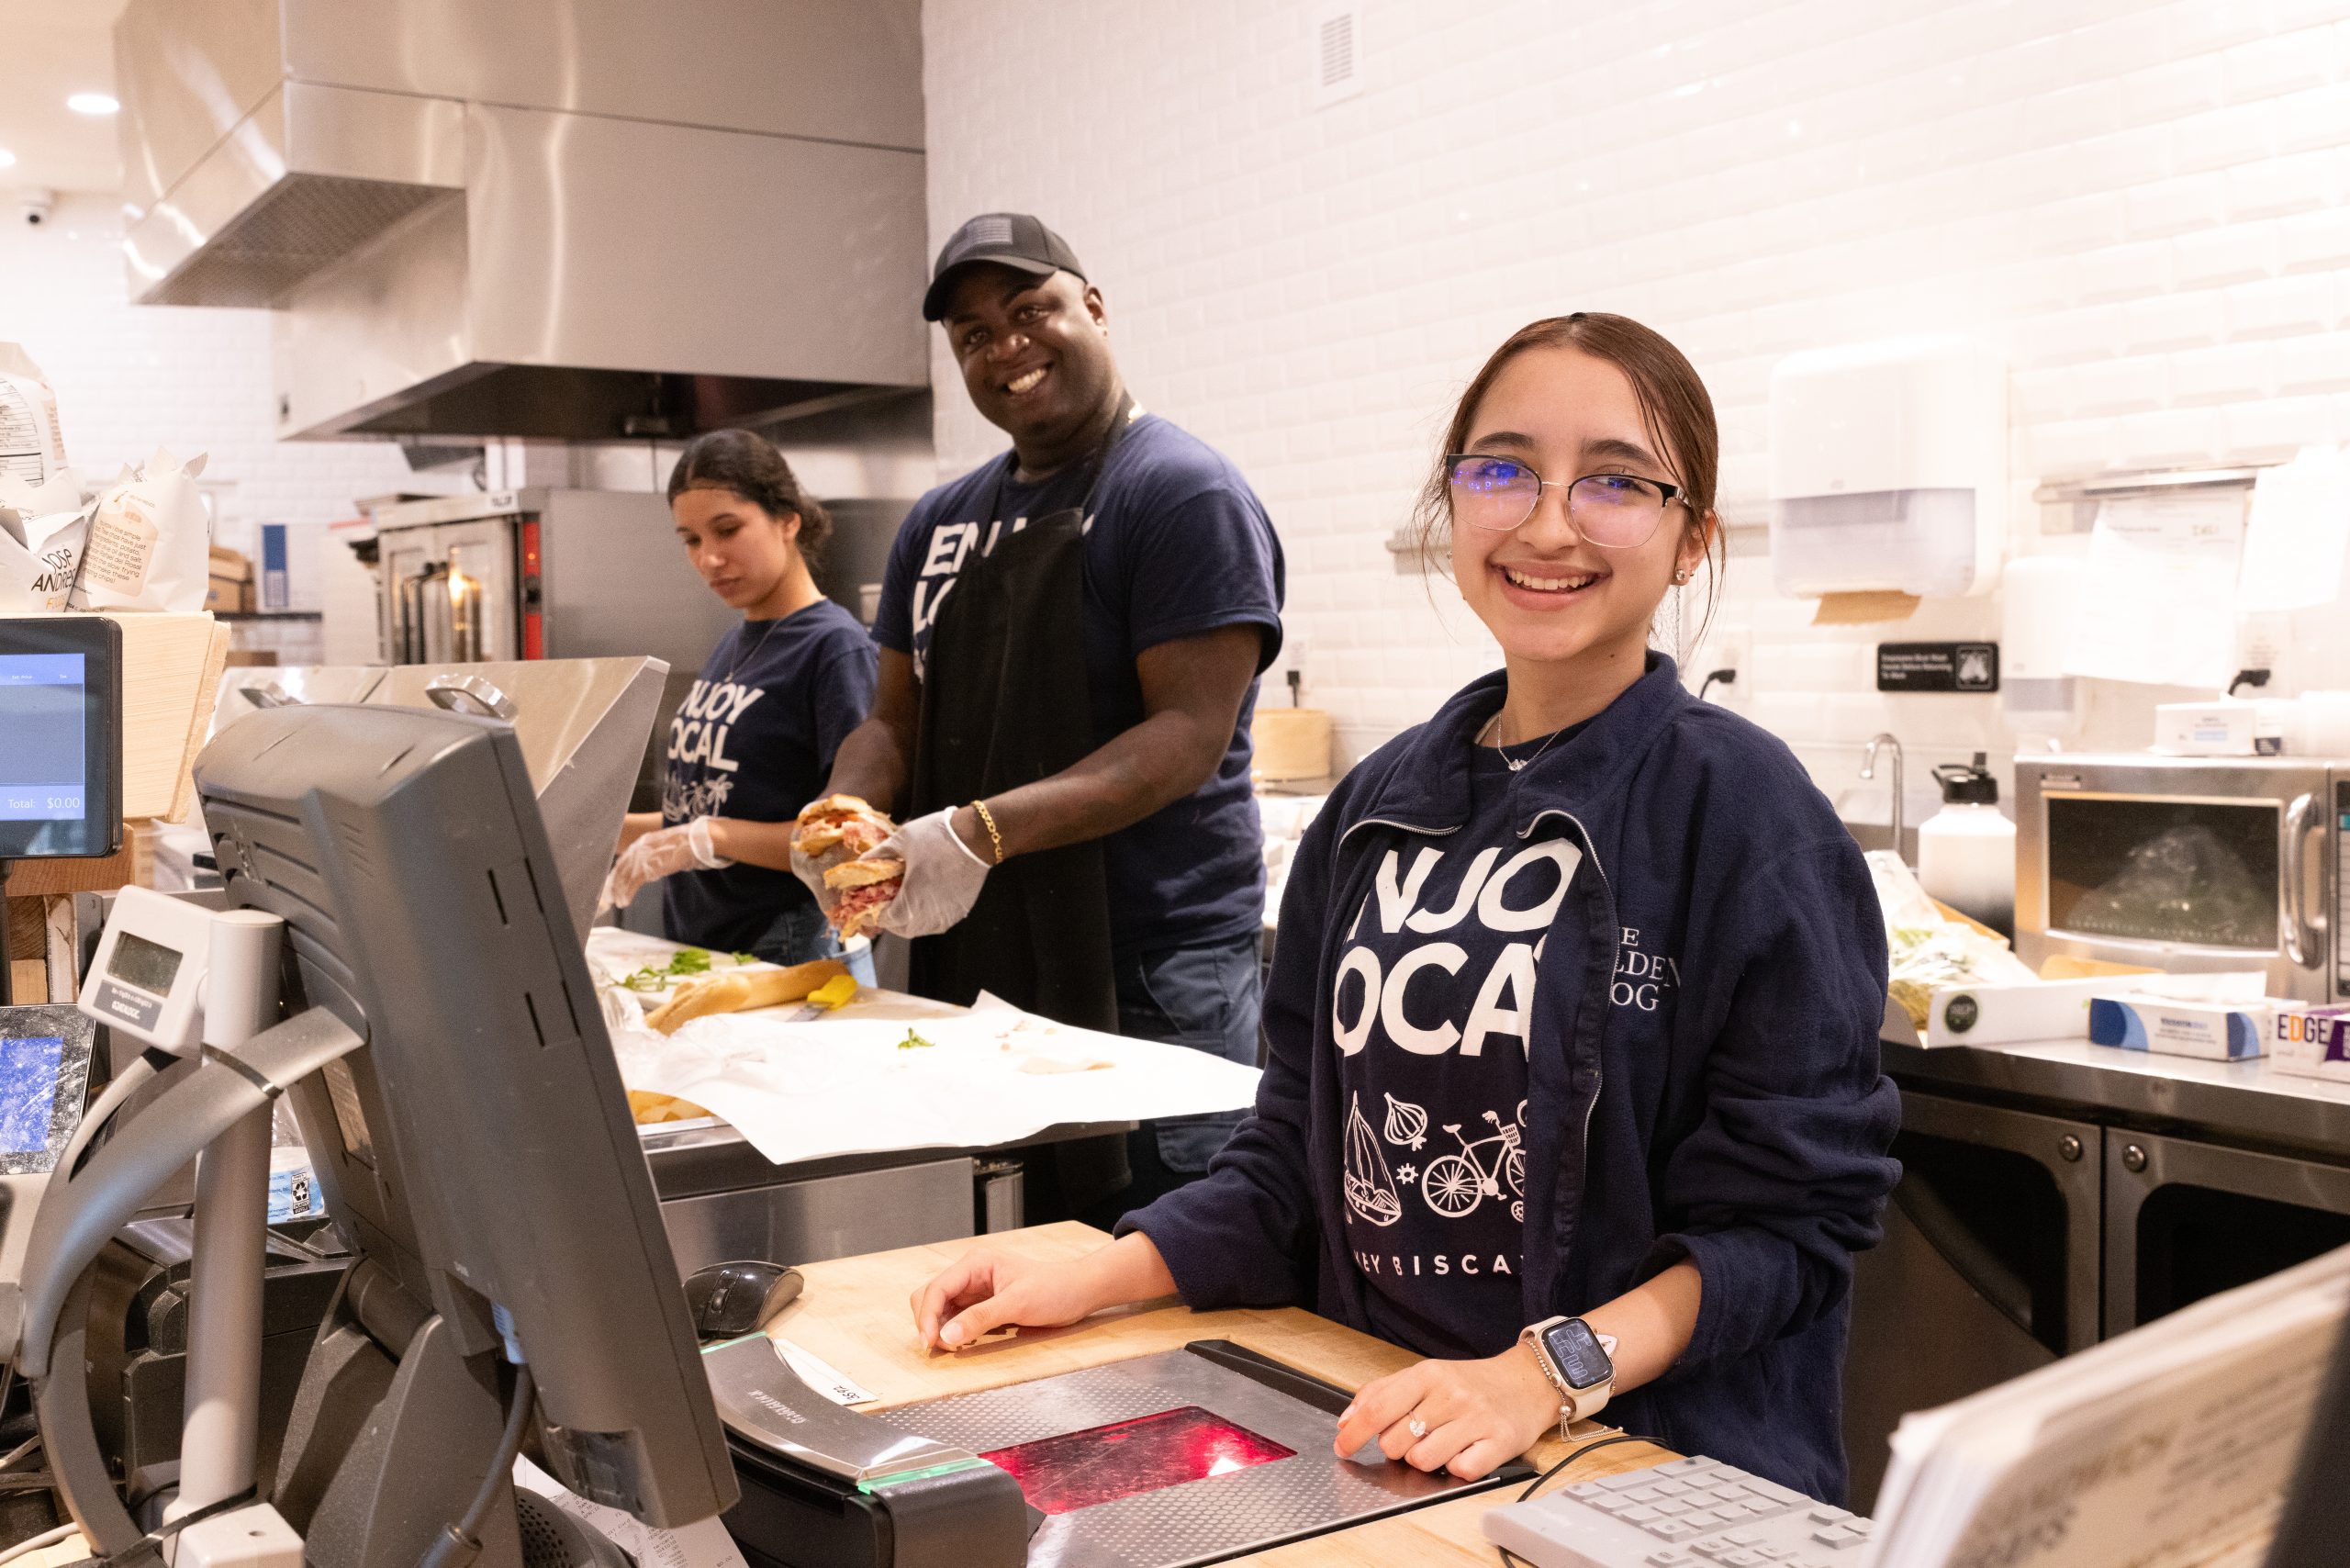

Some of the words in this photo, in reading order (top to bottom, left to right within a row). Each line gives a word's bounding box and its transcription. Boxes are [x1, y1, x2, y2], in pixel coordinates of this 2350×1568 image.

[7, 798, 36, 809] Total:
[47, 797, 80, 810] $0.00
[2277, 1013, 2330, 1045] EDGE
[1392, 1254, 1524, 1276] BISCA
